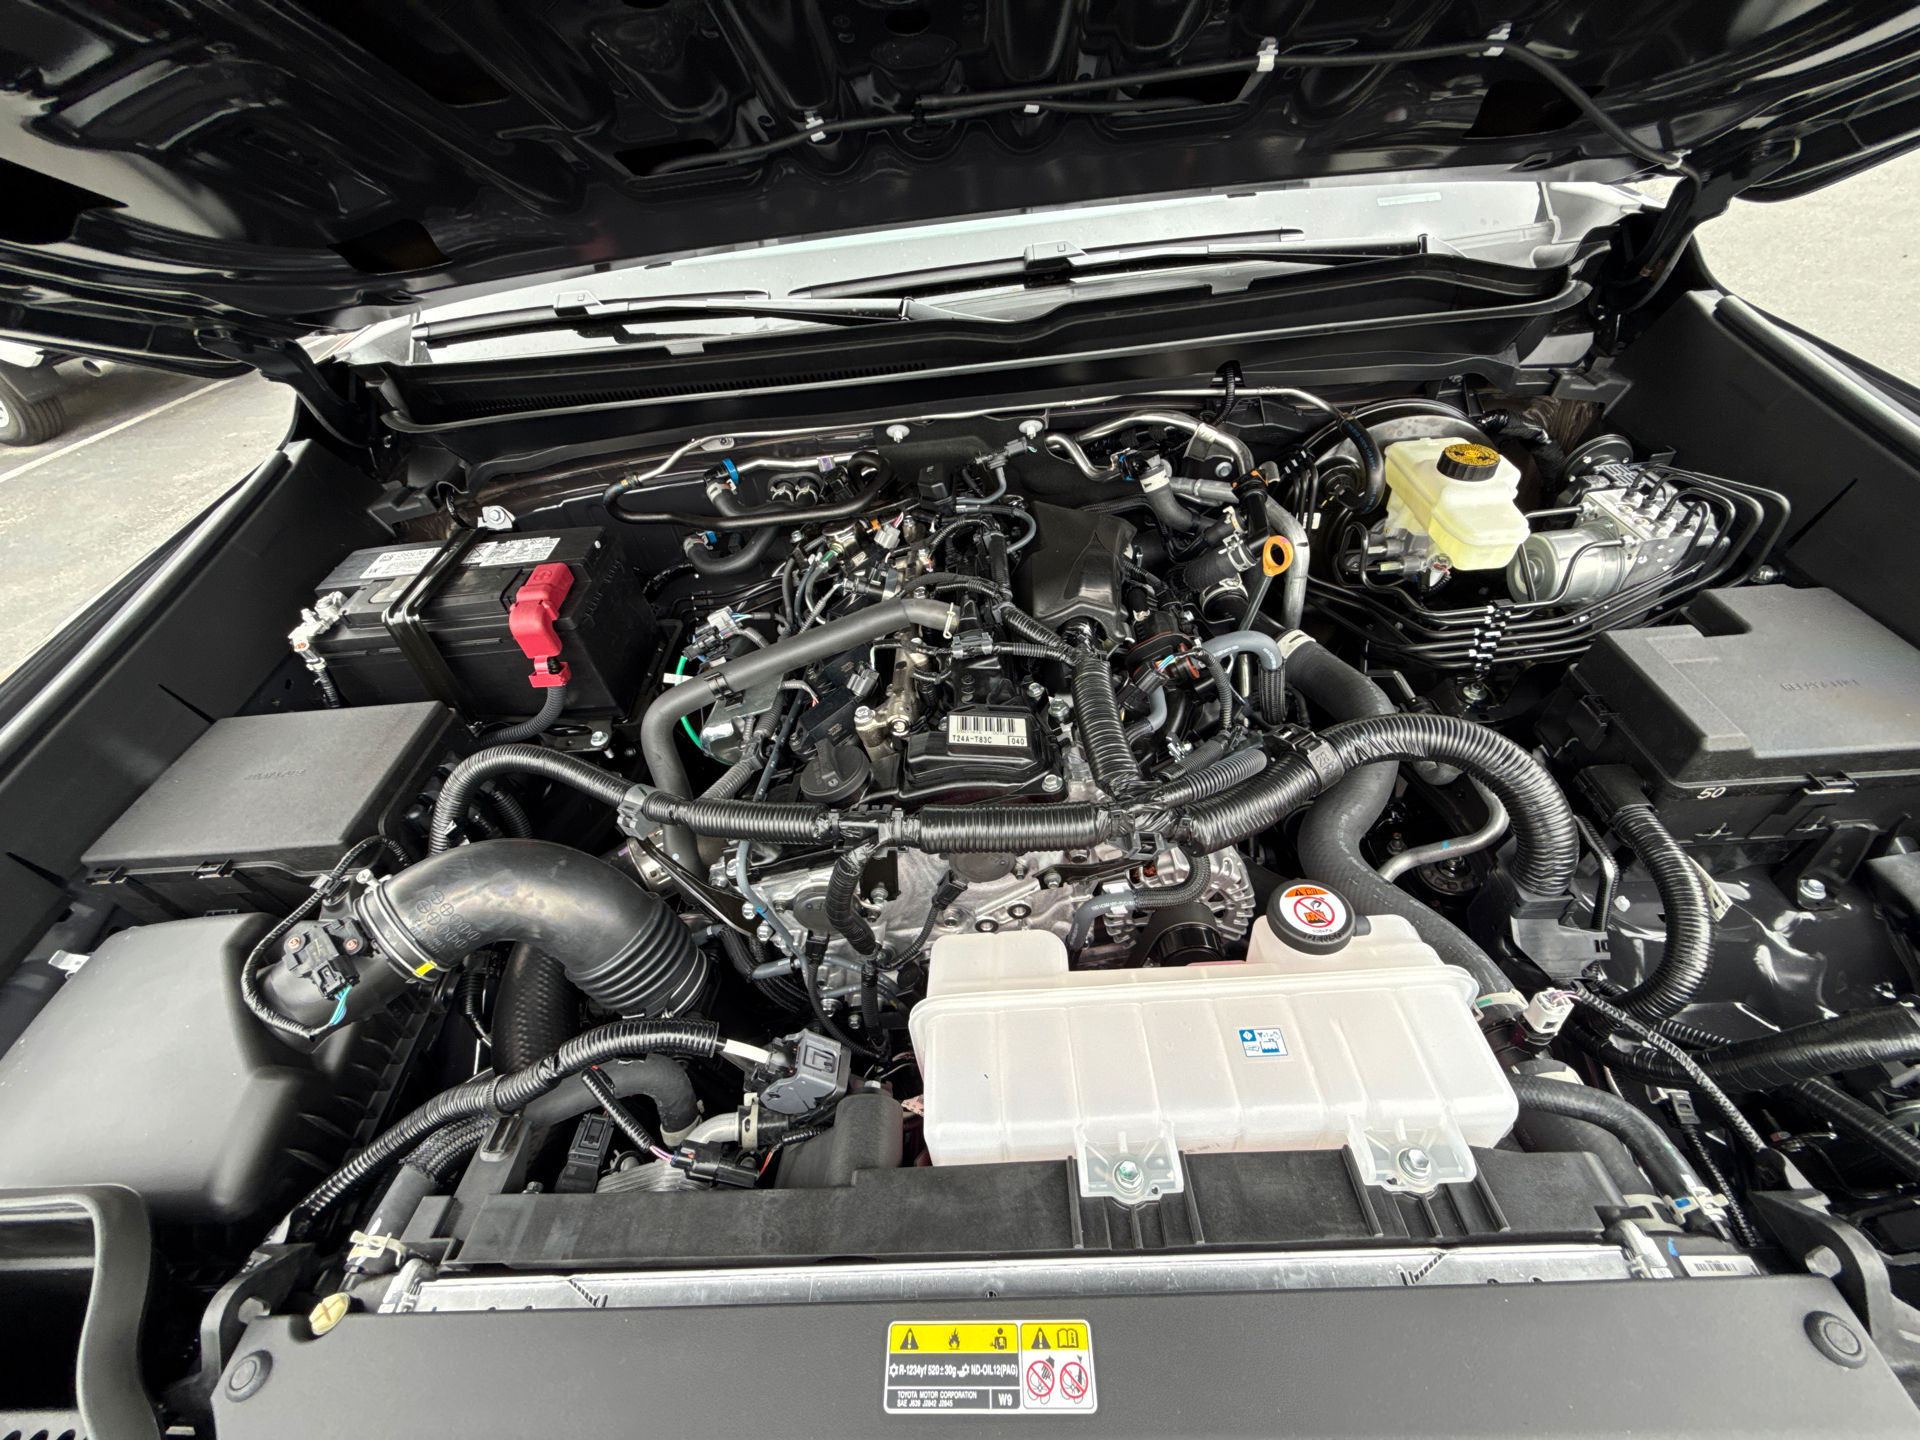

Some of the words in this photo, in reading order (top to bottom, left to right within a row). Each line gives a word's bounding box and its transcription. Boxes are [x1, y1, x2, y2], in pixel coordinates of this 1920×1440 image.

[952, 734, 992, 744] T24A-T83C
[1011, 737, 1025, 745] 040
[1696, 786, 1727, 800] 50
[1303, 931, 1342, 942] DENSO
[899, 1364, 927, 1378] R-1234yf
[897, 1390, 918, 1399] TOYOTA
[919, 1390, 939, 1399] MOTOR
[939, 1390, 977, 1399] CORPORATION
[998, 1393, 1013, 1406] W9
[896, 1399, 908, 1407] SAE
